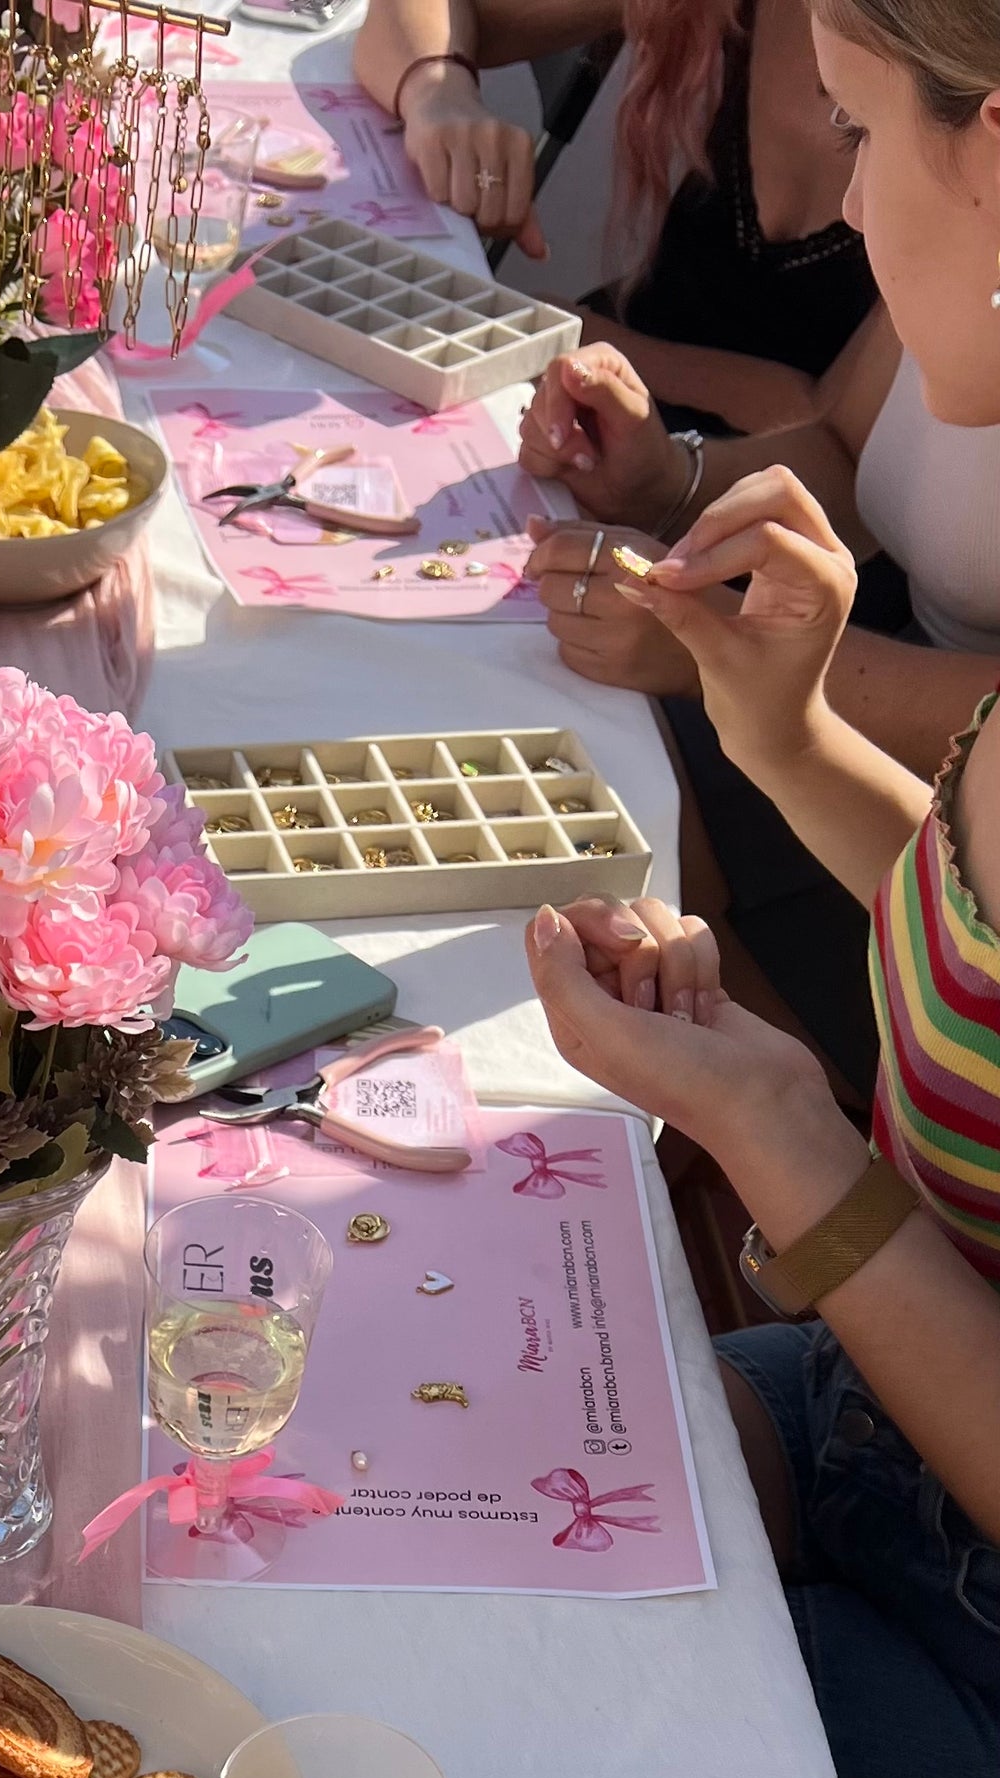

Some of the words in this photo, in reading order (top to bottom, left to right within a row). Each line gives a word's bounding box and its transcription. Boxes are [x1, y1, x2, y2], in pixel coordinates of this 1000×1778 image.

[560, 1220, 583, 1330] www.miarabcn.com
[580, 1366, 603, 1434] @miarabcn
[350, 1488, 412, 1500] contar
[416, 1489, 472, 1502] poder
[477, 1493, 502, 1504] de
[312, 1504, 406, 1517] content
[411, 1505, 453, 1518] muy
[458, 1510, 539, 1523] Estamos
